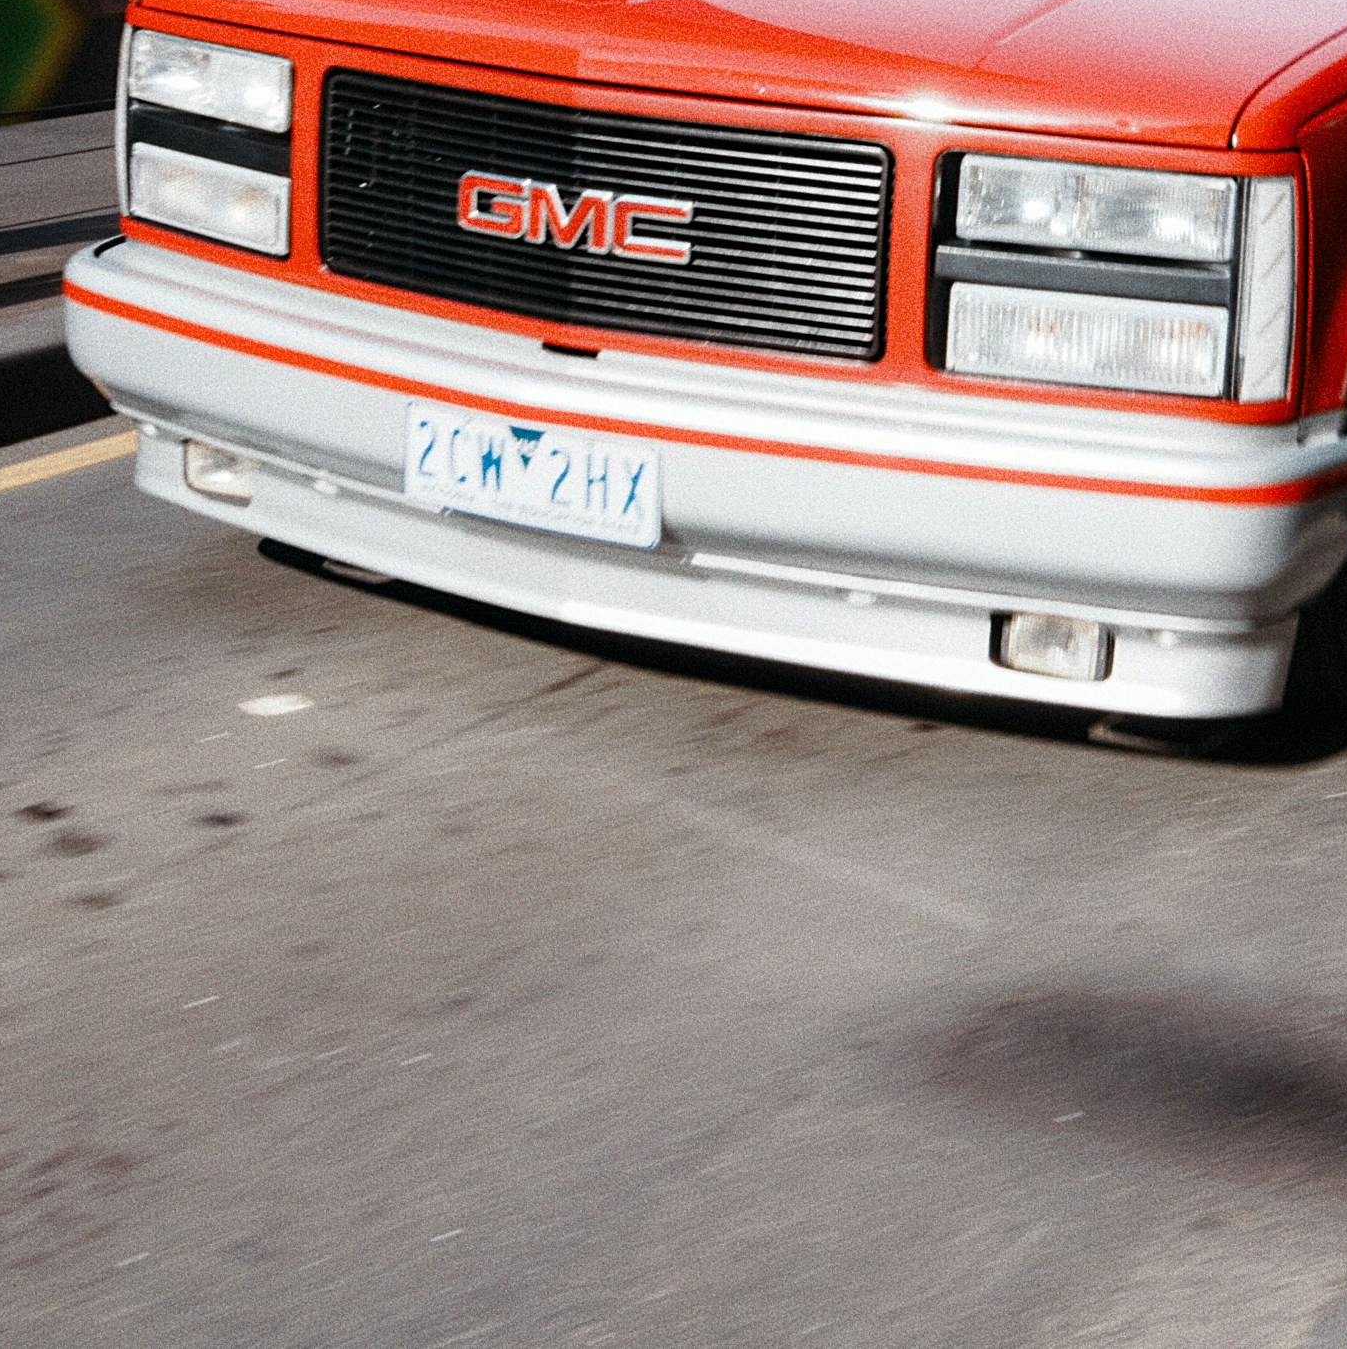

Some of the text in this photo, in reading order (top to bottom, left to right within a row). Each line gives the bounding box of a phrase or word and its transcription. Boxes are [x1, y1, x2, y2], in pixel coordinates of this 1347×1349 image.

[457, 169, 694, 265] GMC
[418, 419, 504, 490] 2CW
[550, 448, 645, 517] 2HX
